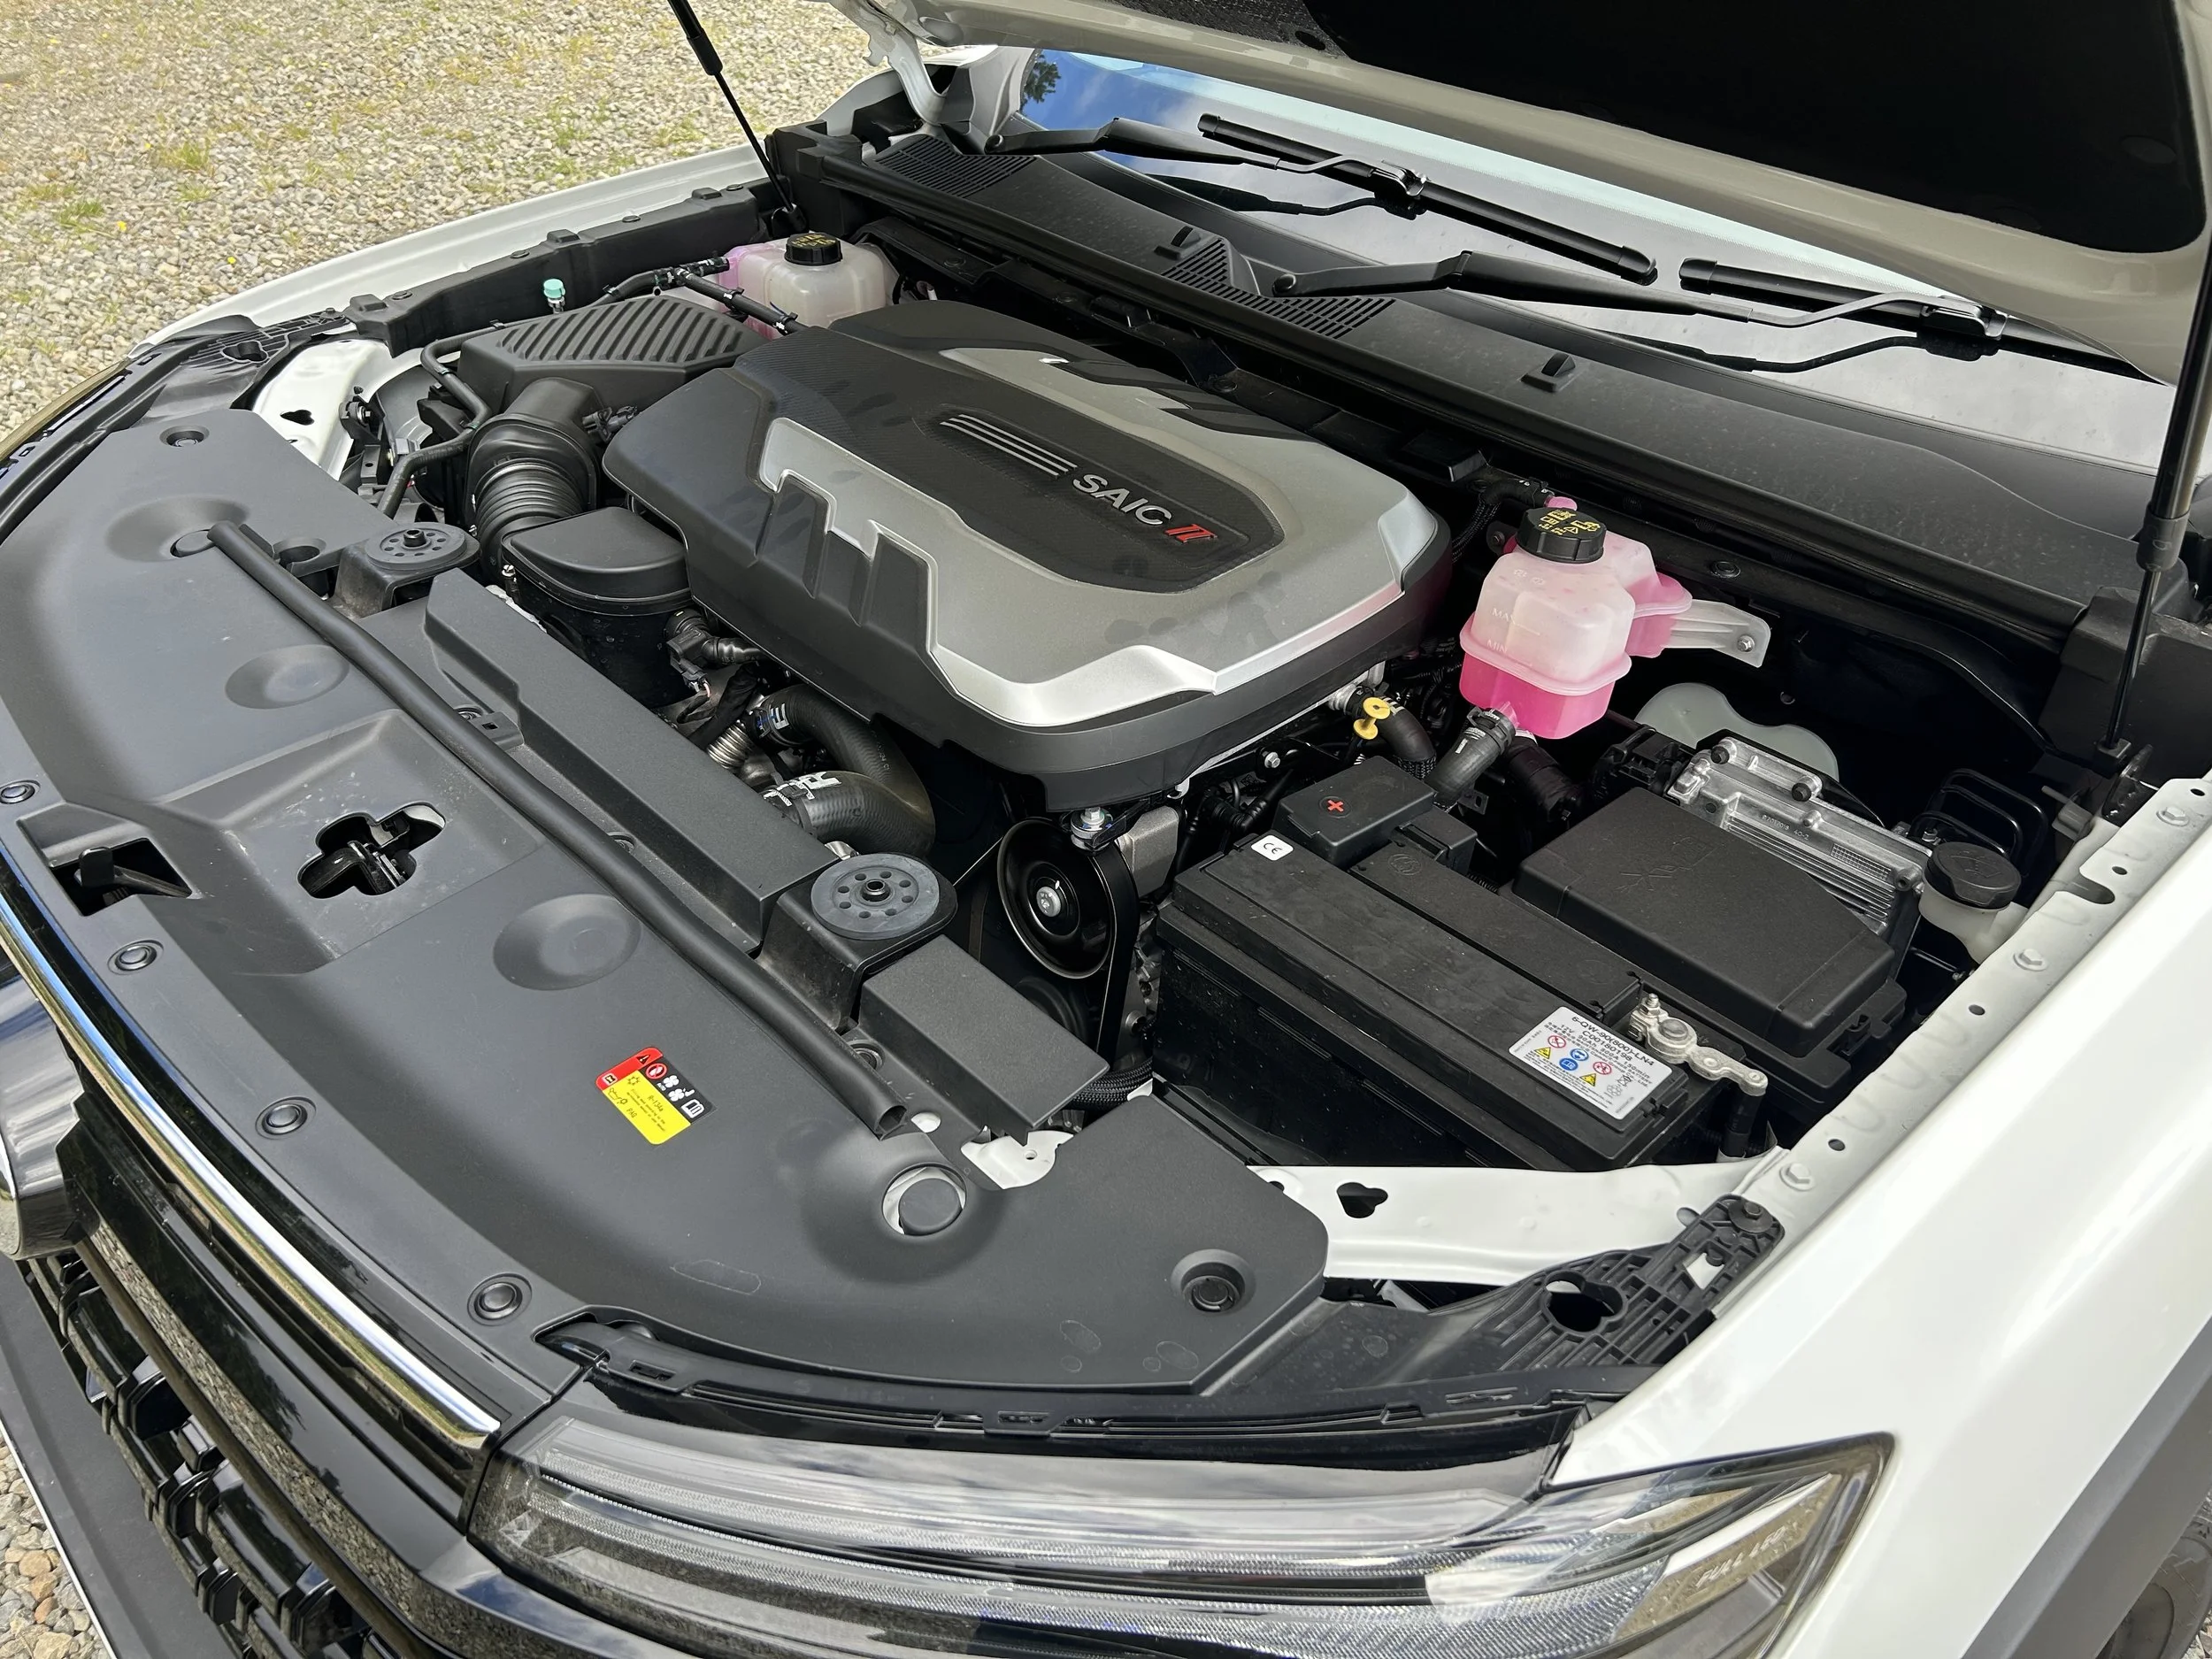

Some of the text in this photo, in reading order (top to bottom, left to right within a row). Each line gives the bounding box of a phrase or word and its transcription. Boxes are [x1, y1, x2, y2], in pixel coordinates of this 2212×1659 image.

[1071, 473, 1173, 526] SAIC
[1487, 640, 1507, 653] MIN
[1263, 842, 1283, 855] CE
[1559, 1024, 1574, 1033] 12V
[1577, 1034, 1597, 1047] 90Ah
[1622, 1061, 1651, 1079] 150min
[1571, 1017, 1655, 1066] 6-QW-90(800)-LN4
[1580, 1030, 1633, 1061] C00180198
[647, 1094, 665, 1111] R-134a
